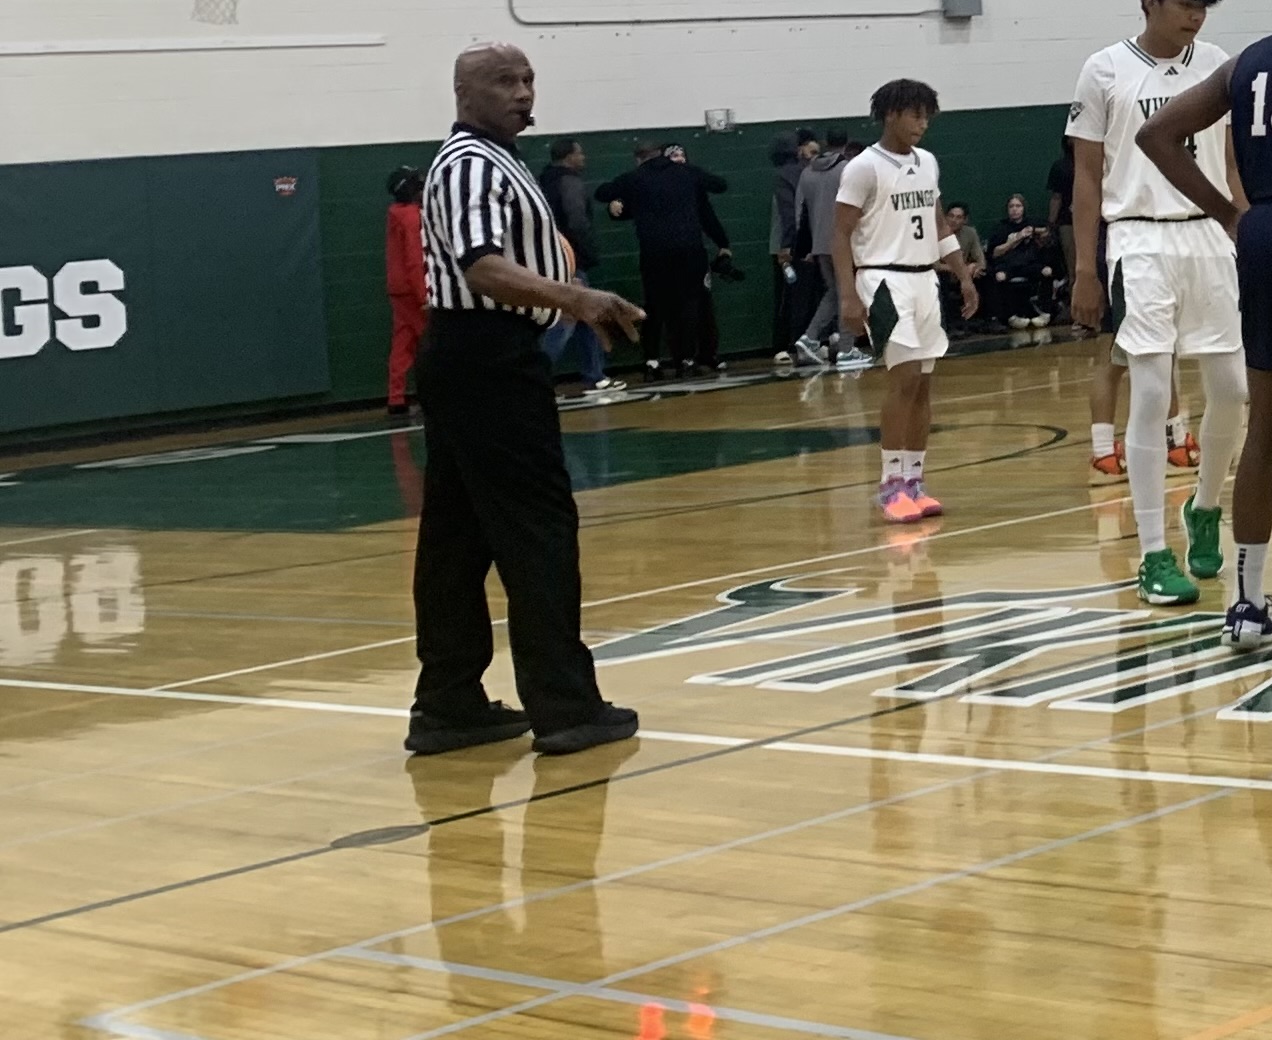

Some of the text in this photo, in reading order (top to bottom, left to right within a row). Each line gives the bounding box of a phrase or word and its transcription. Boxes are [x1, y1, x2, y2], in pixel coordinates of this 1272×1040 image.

[891, 190, 935, 211] VIKINGS
[911, 215, 924, 240] 3
[0, 259, 127, 359] GS
